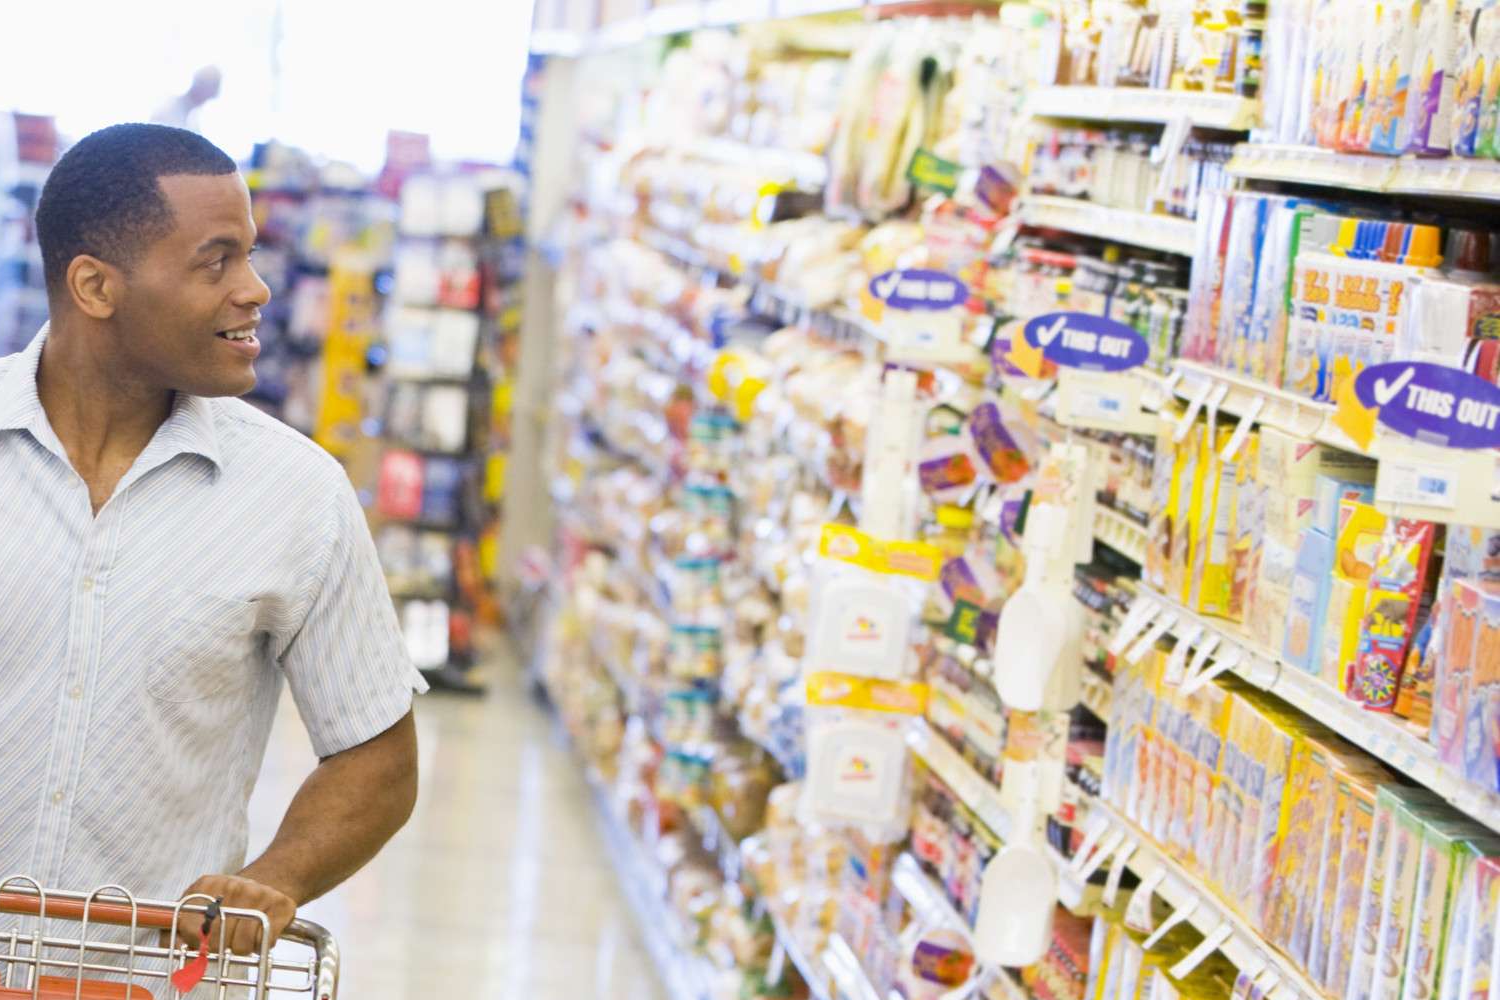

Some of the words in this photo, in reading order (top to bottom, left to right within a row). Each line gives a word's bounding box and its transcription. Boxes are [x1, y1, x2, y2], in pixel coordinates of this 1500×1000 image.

[1061, 328, 1097, 353] THIS
[1099, 334, 1134, 359] OUT
[1405, 383, 1456, 419] THIS
[1456, 397, 1500, 430] OUT
